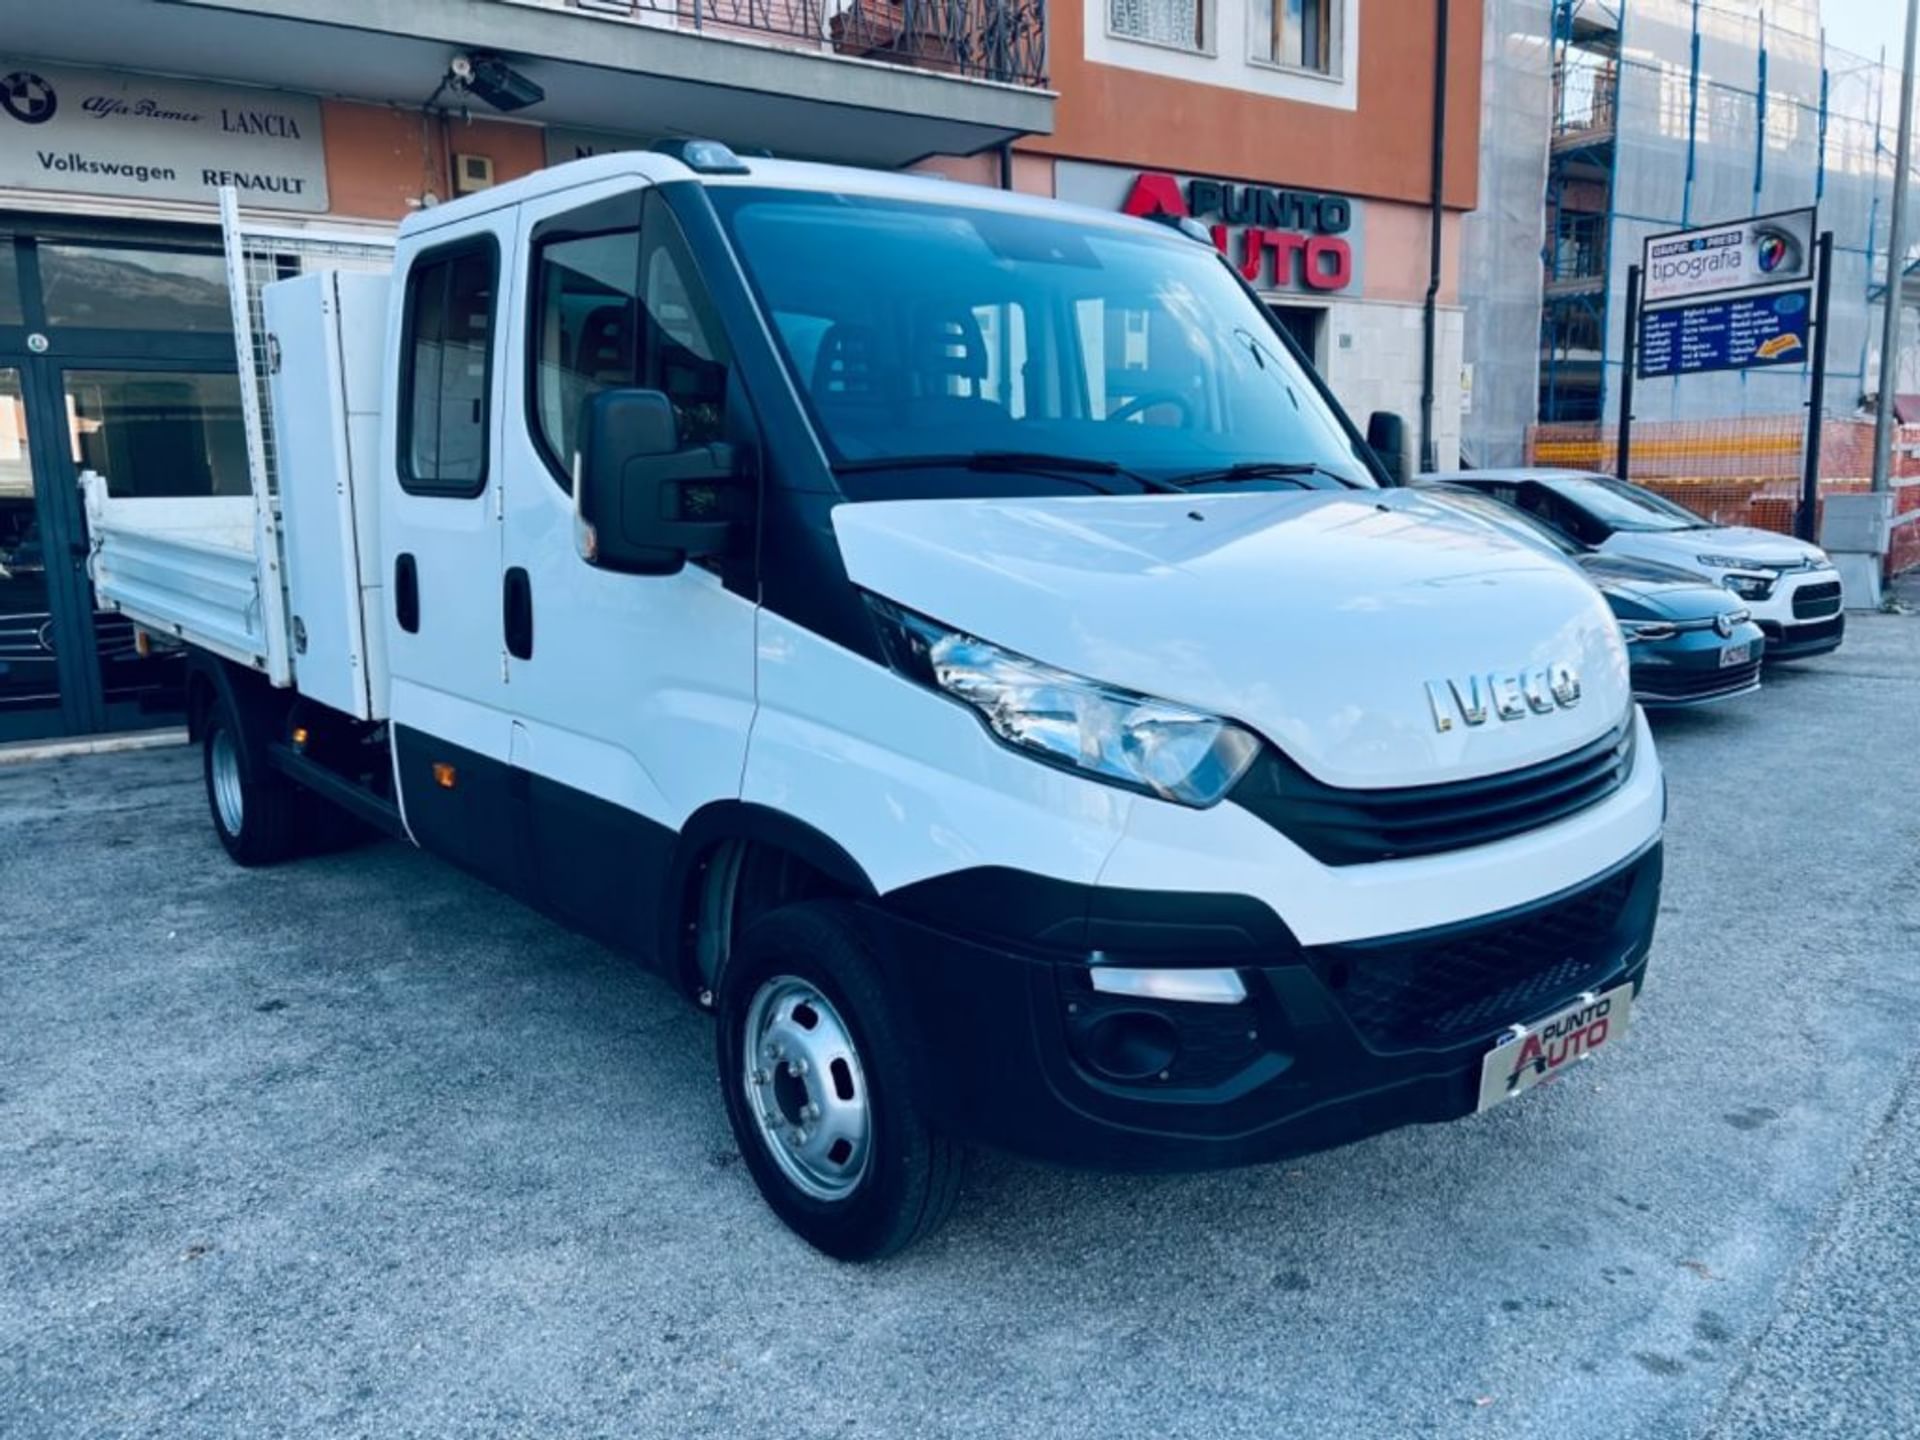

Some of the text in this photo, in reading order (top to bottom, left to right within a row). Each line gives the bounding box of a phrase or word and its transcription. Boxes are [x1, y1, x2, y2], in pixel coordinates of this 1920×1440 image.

[81, 95, 301, 139] Alfa Romeo LANCIA
[37, 151, 305, 194] Volkswagen RENAULT
[1652, 247, 1741, 282] tipografia
[1424, 659, 1581, 733] IVECO
